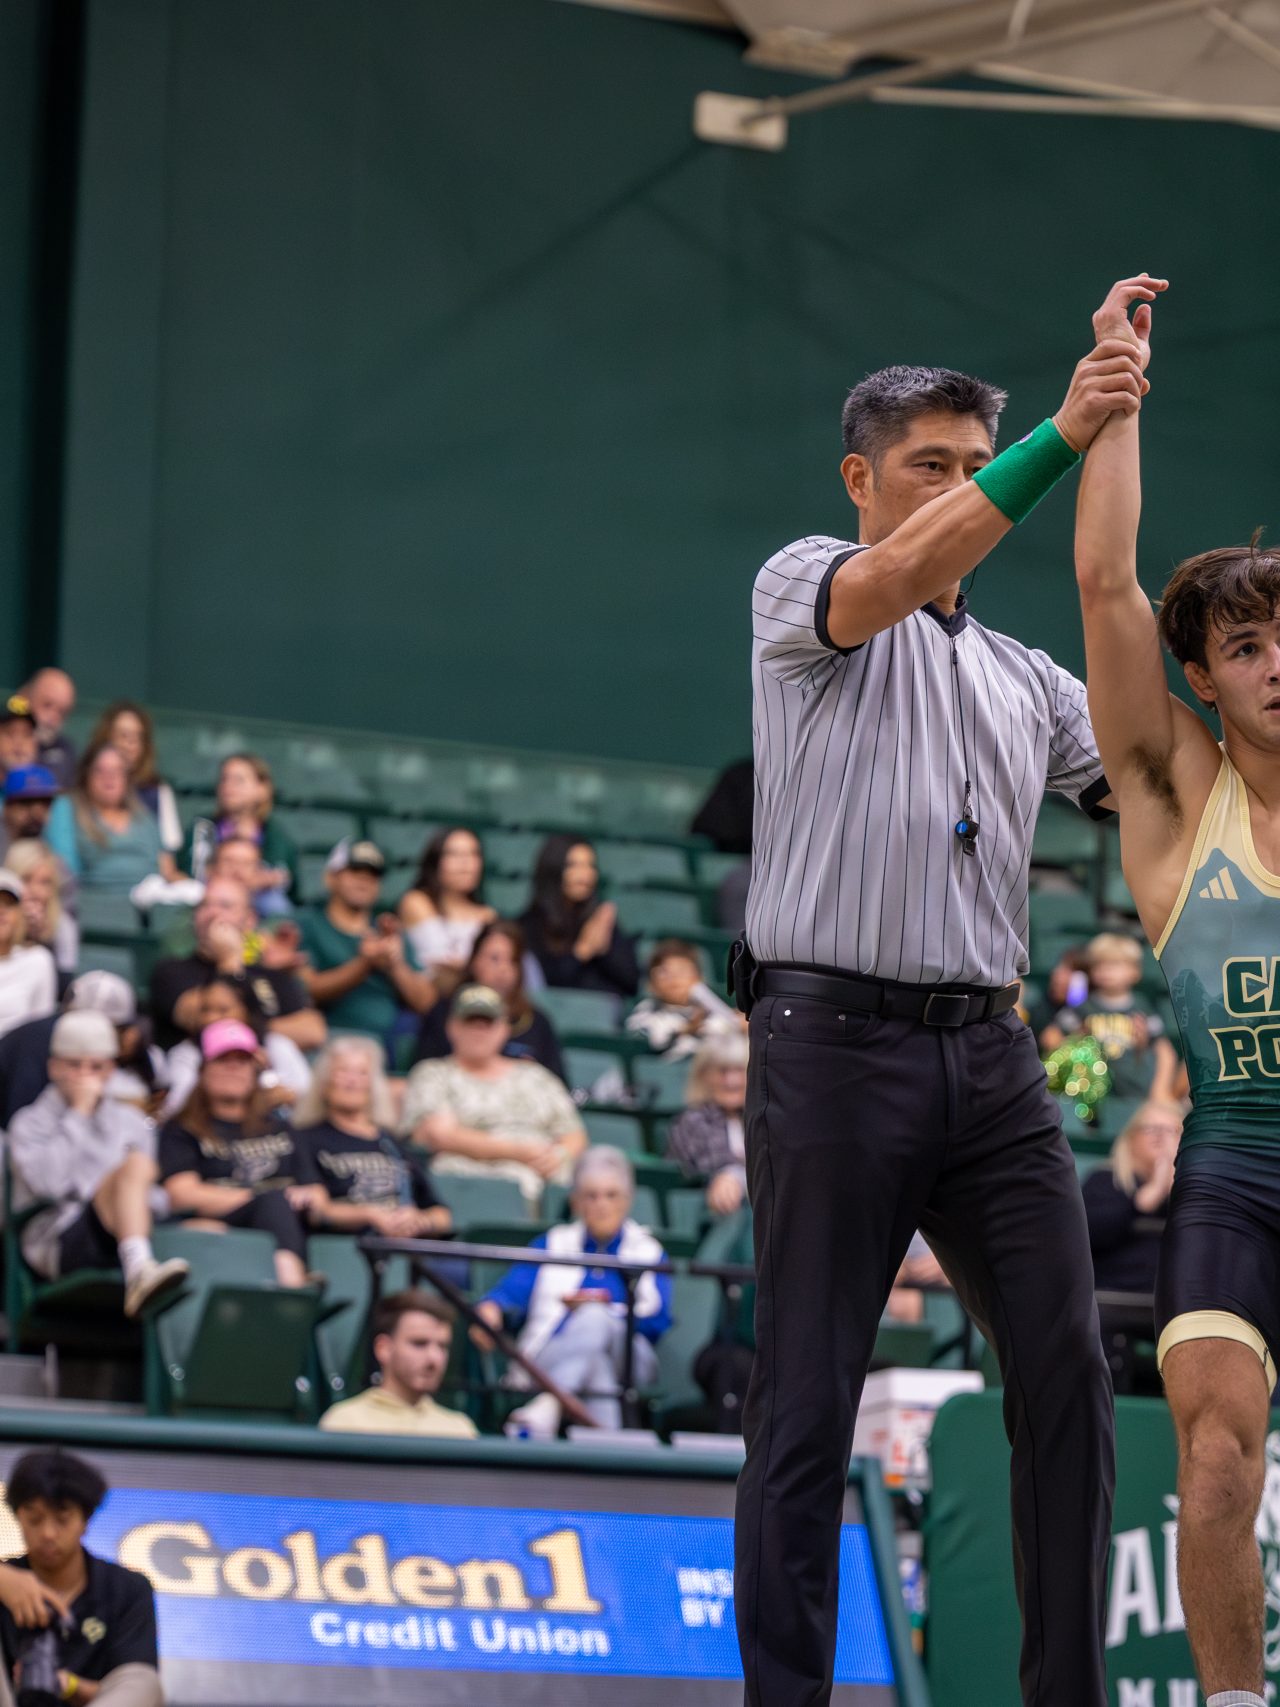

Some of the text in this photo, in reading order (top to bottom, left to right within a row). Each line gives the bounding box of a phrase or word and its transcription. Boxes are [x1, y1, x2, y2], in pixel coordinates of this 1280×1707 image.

[681, 1598, 725, 1629] BY
[309, 1611, 611, 1657] Credit Union
